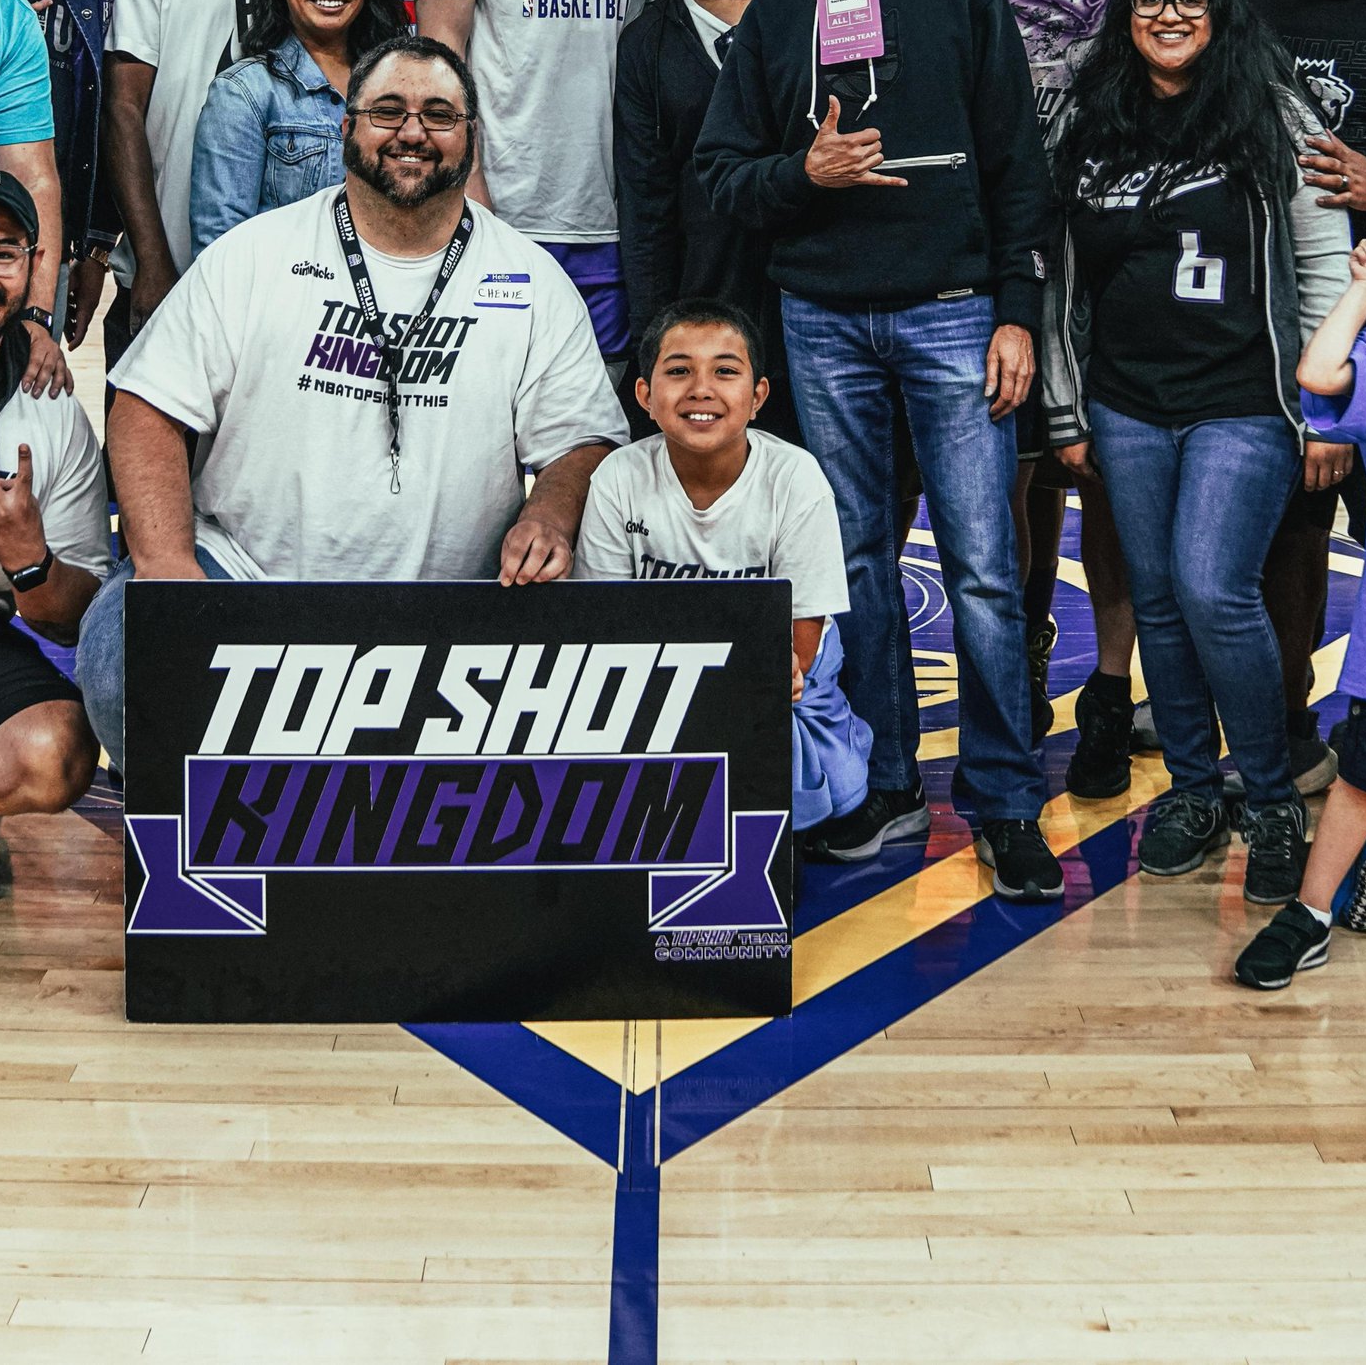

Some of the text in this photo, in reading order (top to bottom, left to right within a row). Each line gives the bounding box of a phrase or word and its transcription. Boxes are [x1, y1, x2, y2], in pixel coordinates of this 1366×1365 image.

[831, 17, 849, 26] ALL
[822, 31, 877, 47] VISITING TEAM
[1172, 229, 1227, 304] 6
[478, 286, 524, 301] CHEWIE
[383, 312, 479, 349] SHOT
[198, 642, 733, 755] TOP SHOT
[194, 762, 717, 865] KINGDOM
[654, 934, 670, 947] A
[737, 931, 789, 946] TEAM
[654, 944, 793, 962] COMMUNITY
